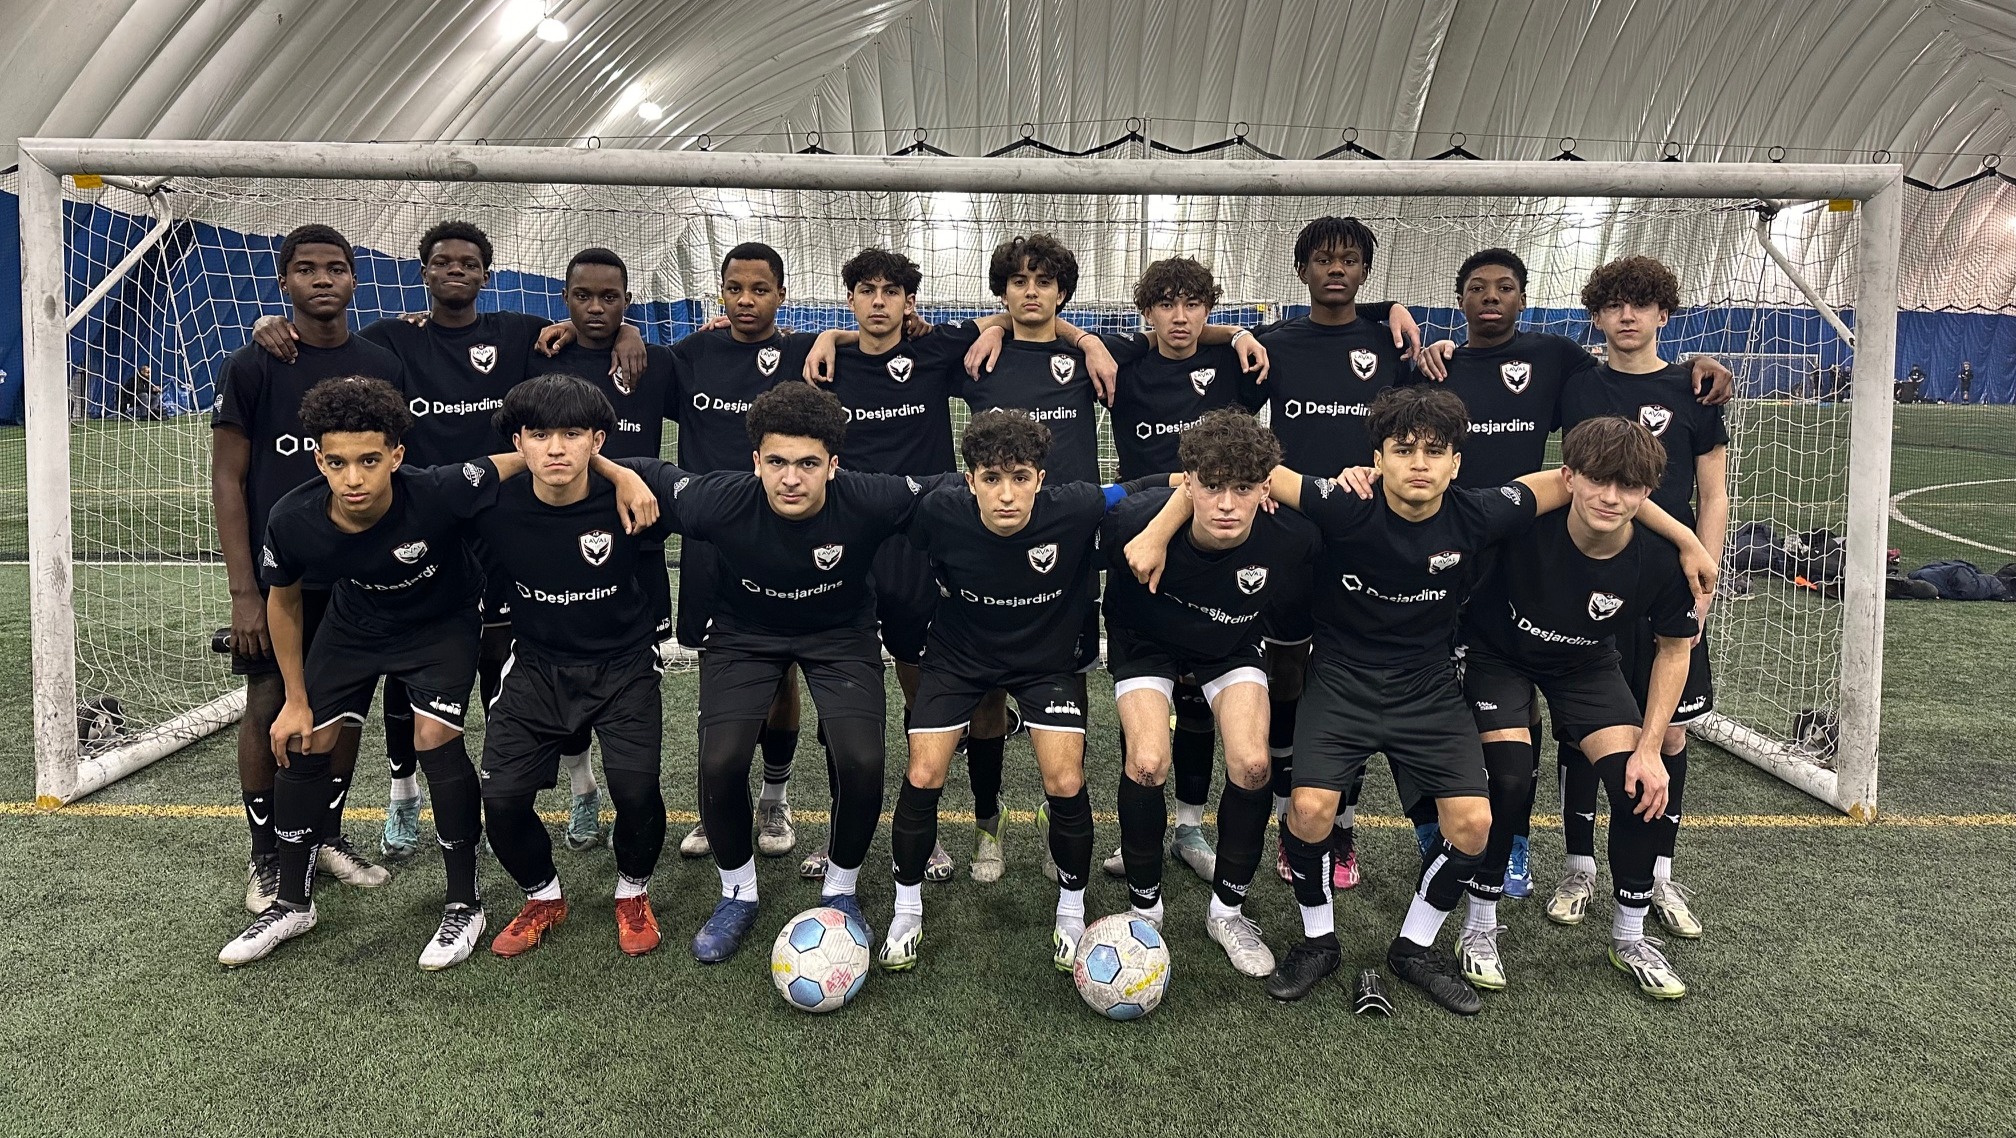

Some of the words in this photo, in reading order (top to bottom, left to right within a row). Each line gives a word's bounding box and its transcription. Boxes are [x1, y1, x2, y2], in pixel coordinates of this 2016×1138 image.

[433, 398, 504, 415] Desjardins
[713, 399, 753, 414] Desjar
[856, 404, 926, 421] Desjardins
[1305, 401, 1371, 416] Desjardin
[584, 537, 608, 545] LAVAL
[534, 585, 618, 605] Desjardins
[765, 580, 843, 600] Desjardins
[983, 589, 1062, 607] Desjardins
